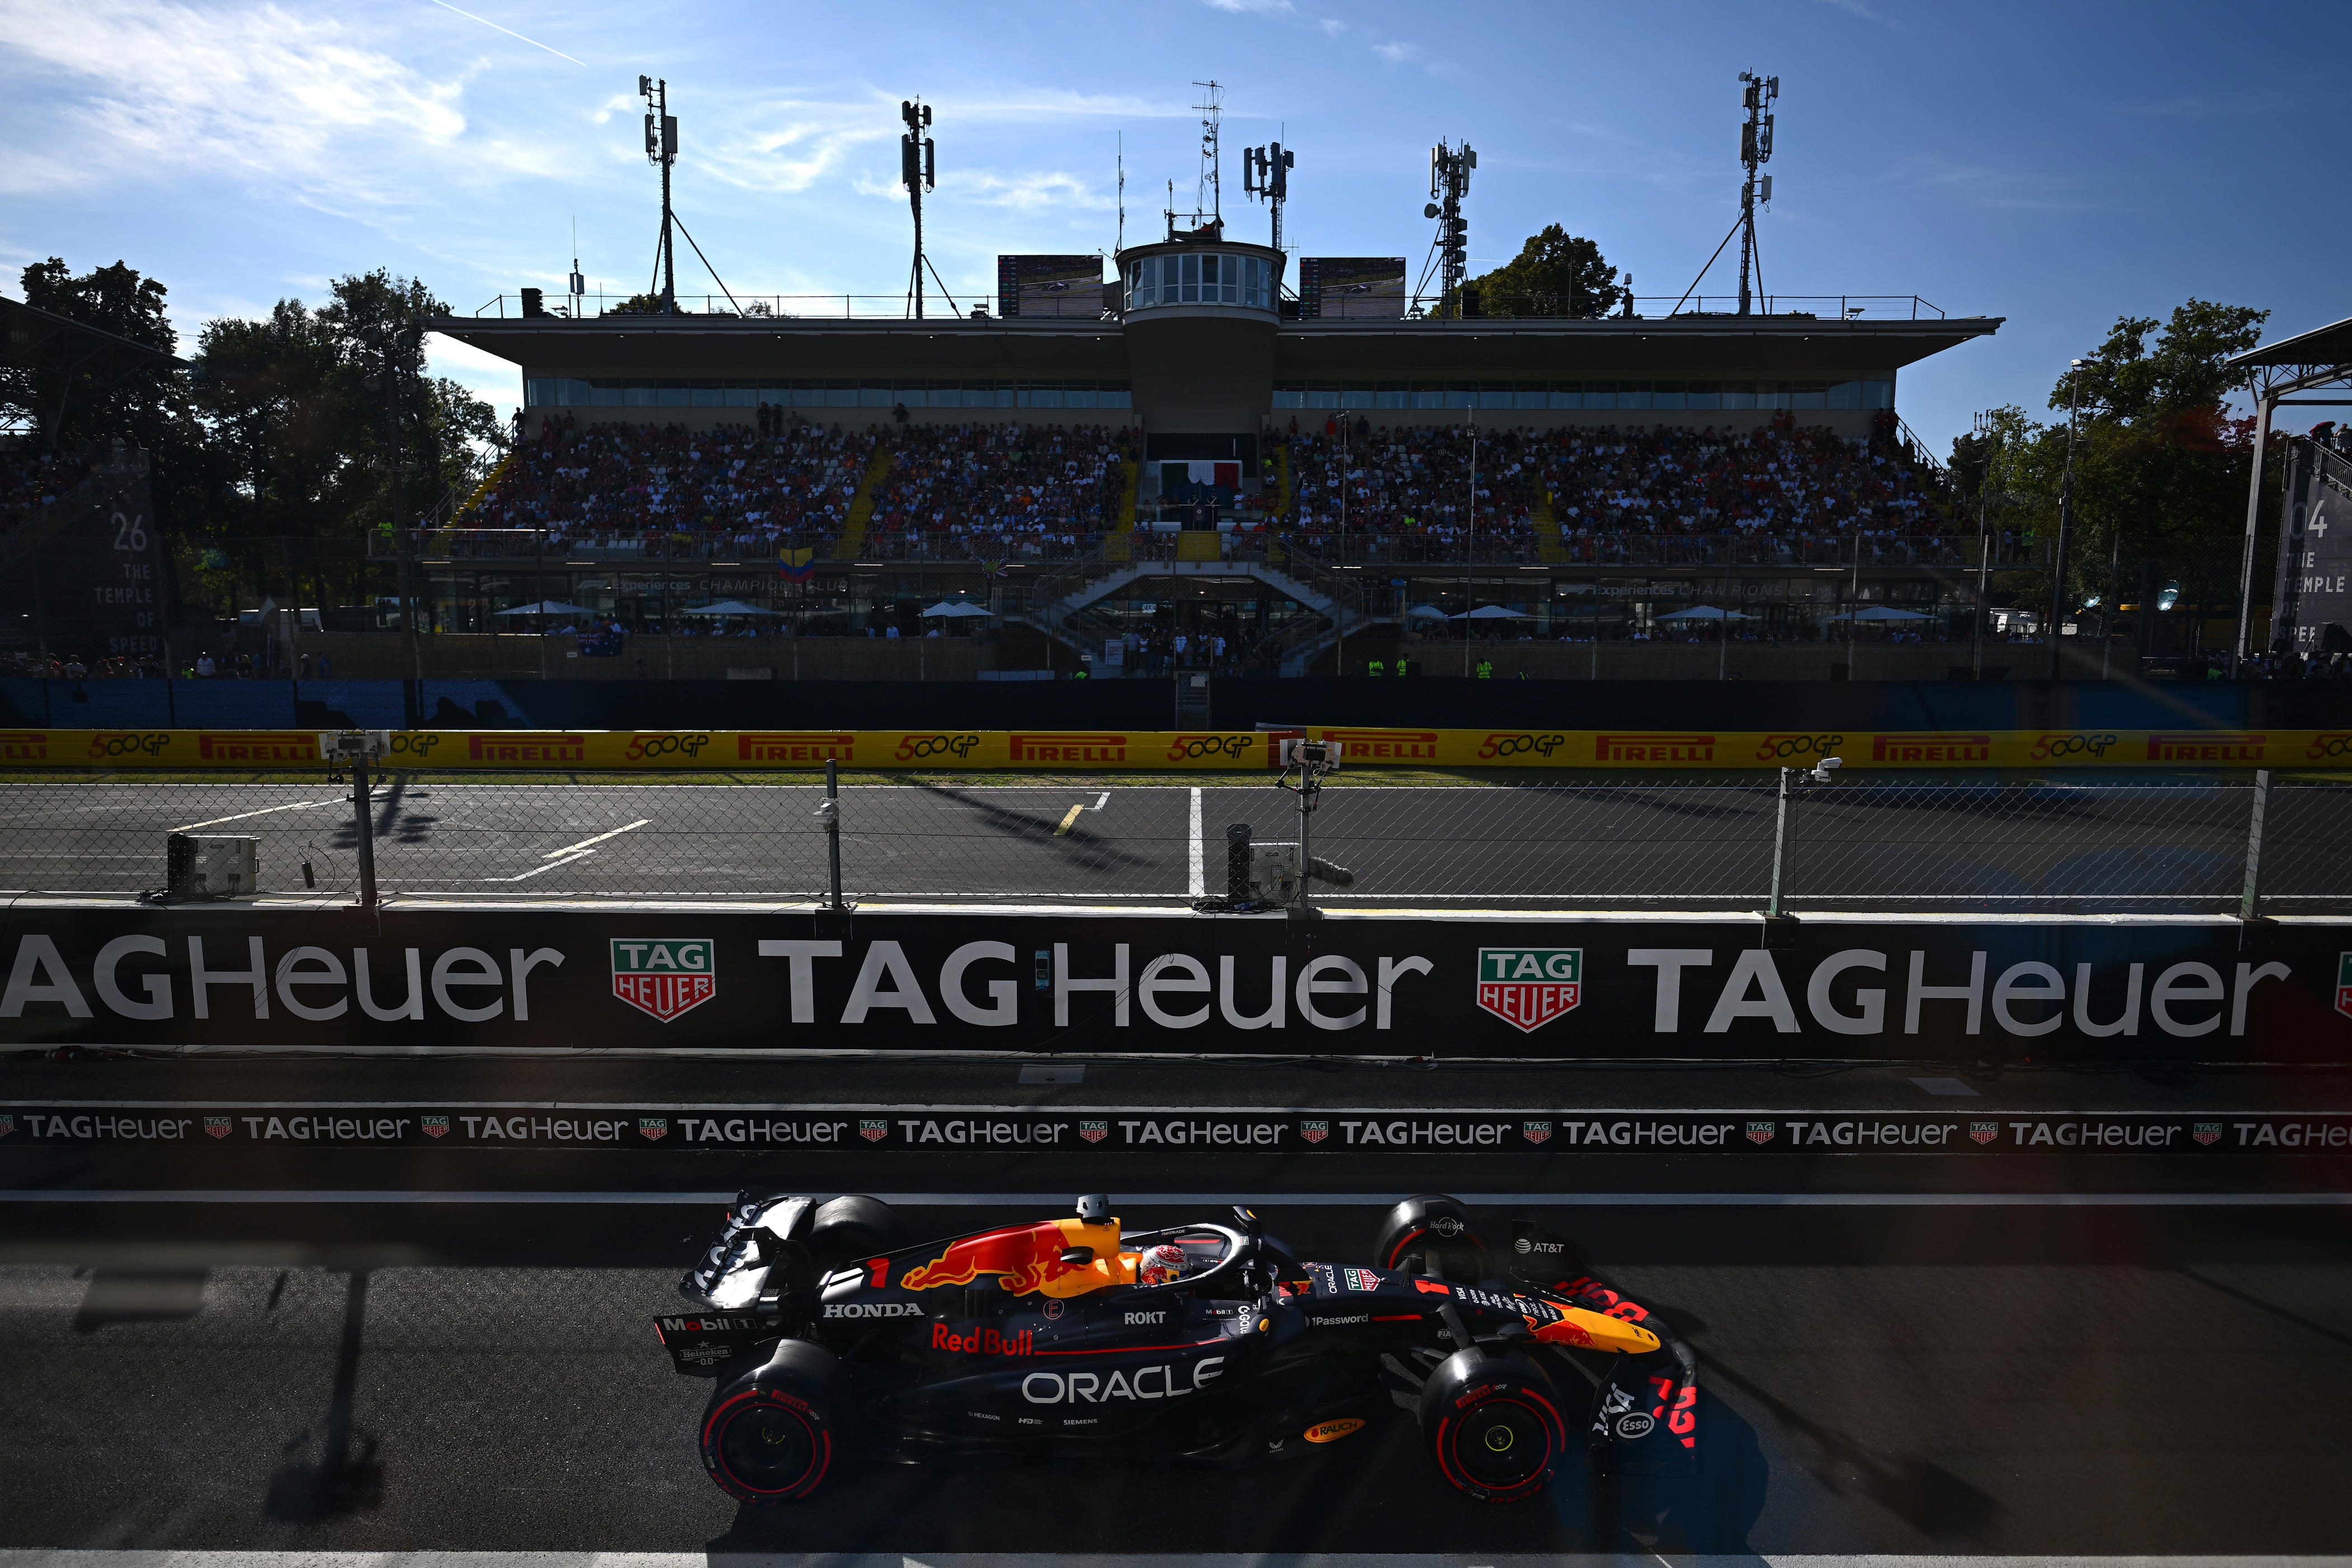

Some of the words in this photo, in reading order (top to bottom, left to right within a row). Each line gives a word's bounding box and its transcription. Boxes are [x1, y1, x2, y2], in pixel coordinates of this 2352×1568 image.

[2290, 499, 2328, 540] 04
[111, 512, 147, 551] 26
[2287, 551, 2315, 568] THE
[123, 564, 150, 579] THE
[700, 580, 795, 591] CHAMPION
[2284, 576, 2345, 593] TEMPLE
[94, 588, 153, 603] TEMPLE
[2282, 602, 2300, 617] OF
[137, 612, 154, 627] OF
[2278, 626, 2316, 643] SPEE
[110, 636, 157, 653] SPEED
[199, 734, 315, 760] PIRELLI
[469, 735, 584, 761] PIRELLI
[738, 735, 854, 761] PIRELLI
[1010, 735, 1127, 762] PIRELLI
[1596, 735, 1716, 761] PIRELLI
[1872, 735, 1991, 762] PIRELLI
[2146, 734, 2267, 761] PIRELLI
[620, 943, 705, 969] TAG
[1487, 953, 1573, 979] TAG
[617, 974, 711, 1015] HEUER
[1483, 985, 1575, 1026] HEUER
[205, 1127, 230, 1137] HEUER
[422, 1126, 446, 1137] HEUER
[641, 1128, 665, 1139] HEUER
[862, 1130, 886, 1140] HEUER
[1081, 1131, 1106, 1141] HEUER
[1302, 1131, 1327, 1141] HEUER
[1526, 1131, 1550, 1142] HEUER
[1748, 1132, 1773, 1142] HEUER
[1971, 1132, 1996, 1142] HEUER
[2195, 1133, 2219, 1144] HEUER
[1533, 1243, 1565, 1253] AT&T
[866, 1258, 890, 1288] 1
[1325, 1264, 1338, 1294] ORACLE
[1348, 1270, 1359, 1290] TAG
[1361, 1270, 1377, 1290] HEUER
[1455, 1287, 1467, 1300] VISA
[1493, 1293, 1504, 1309] TRADE
[823, 1302, 925, 1318] HONDA
[1049, 1300, 1060, 1316] E
[1518, 1301, 1528, 1314] CDW
[663, 1318, 730, 1331] Mobil
[1124, 1311, 1166, 1325] ROKT
[1312, 1314, 1369, 1326] 1Password
[932, 1324, 980, 1354] Red
[984, 1329, 1032, 1356] Bull
[683, 1349, 728, 1358] Heineken
[700, 1357, 714, 1366] 0.0
[1022, 1356, 1225, 1404] ORACLE
[771, 1389, 810, 1412] PIRELLI
[1455, 1384, 1491, 1409] PIRELLI
[974, 1412, 1000, 1421] HEXAGON
[1320, 1421, 1358, 1436] RAUCH
